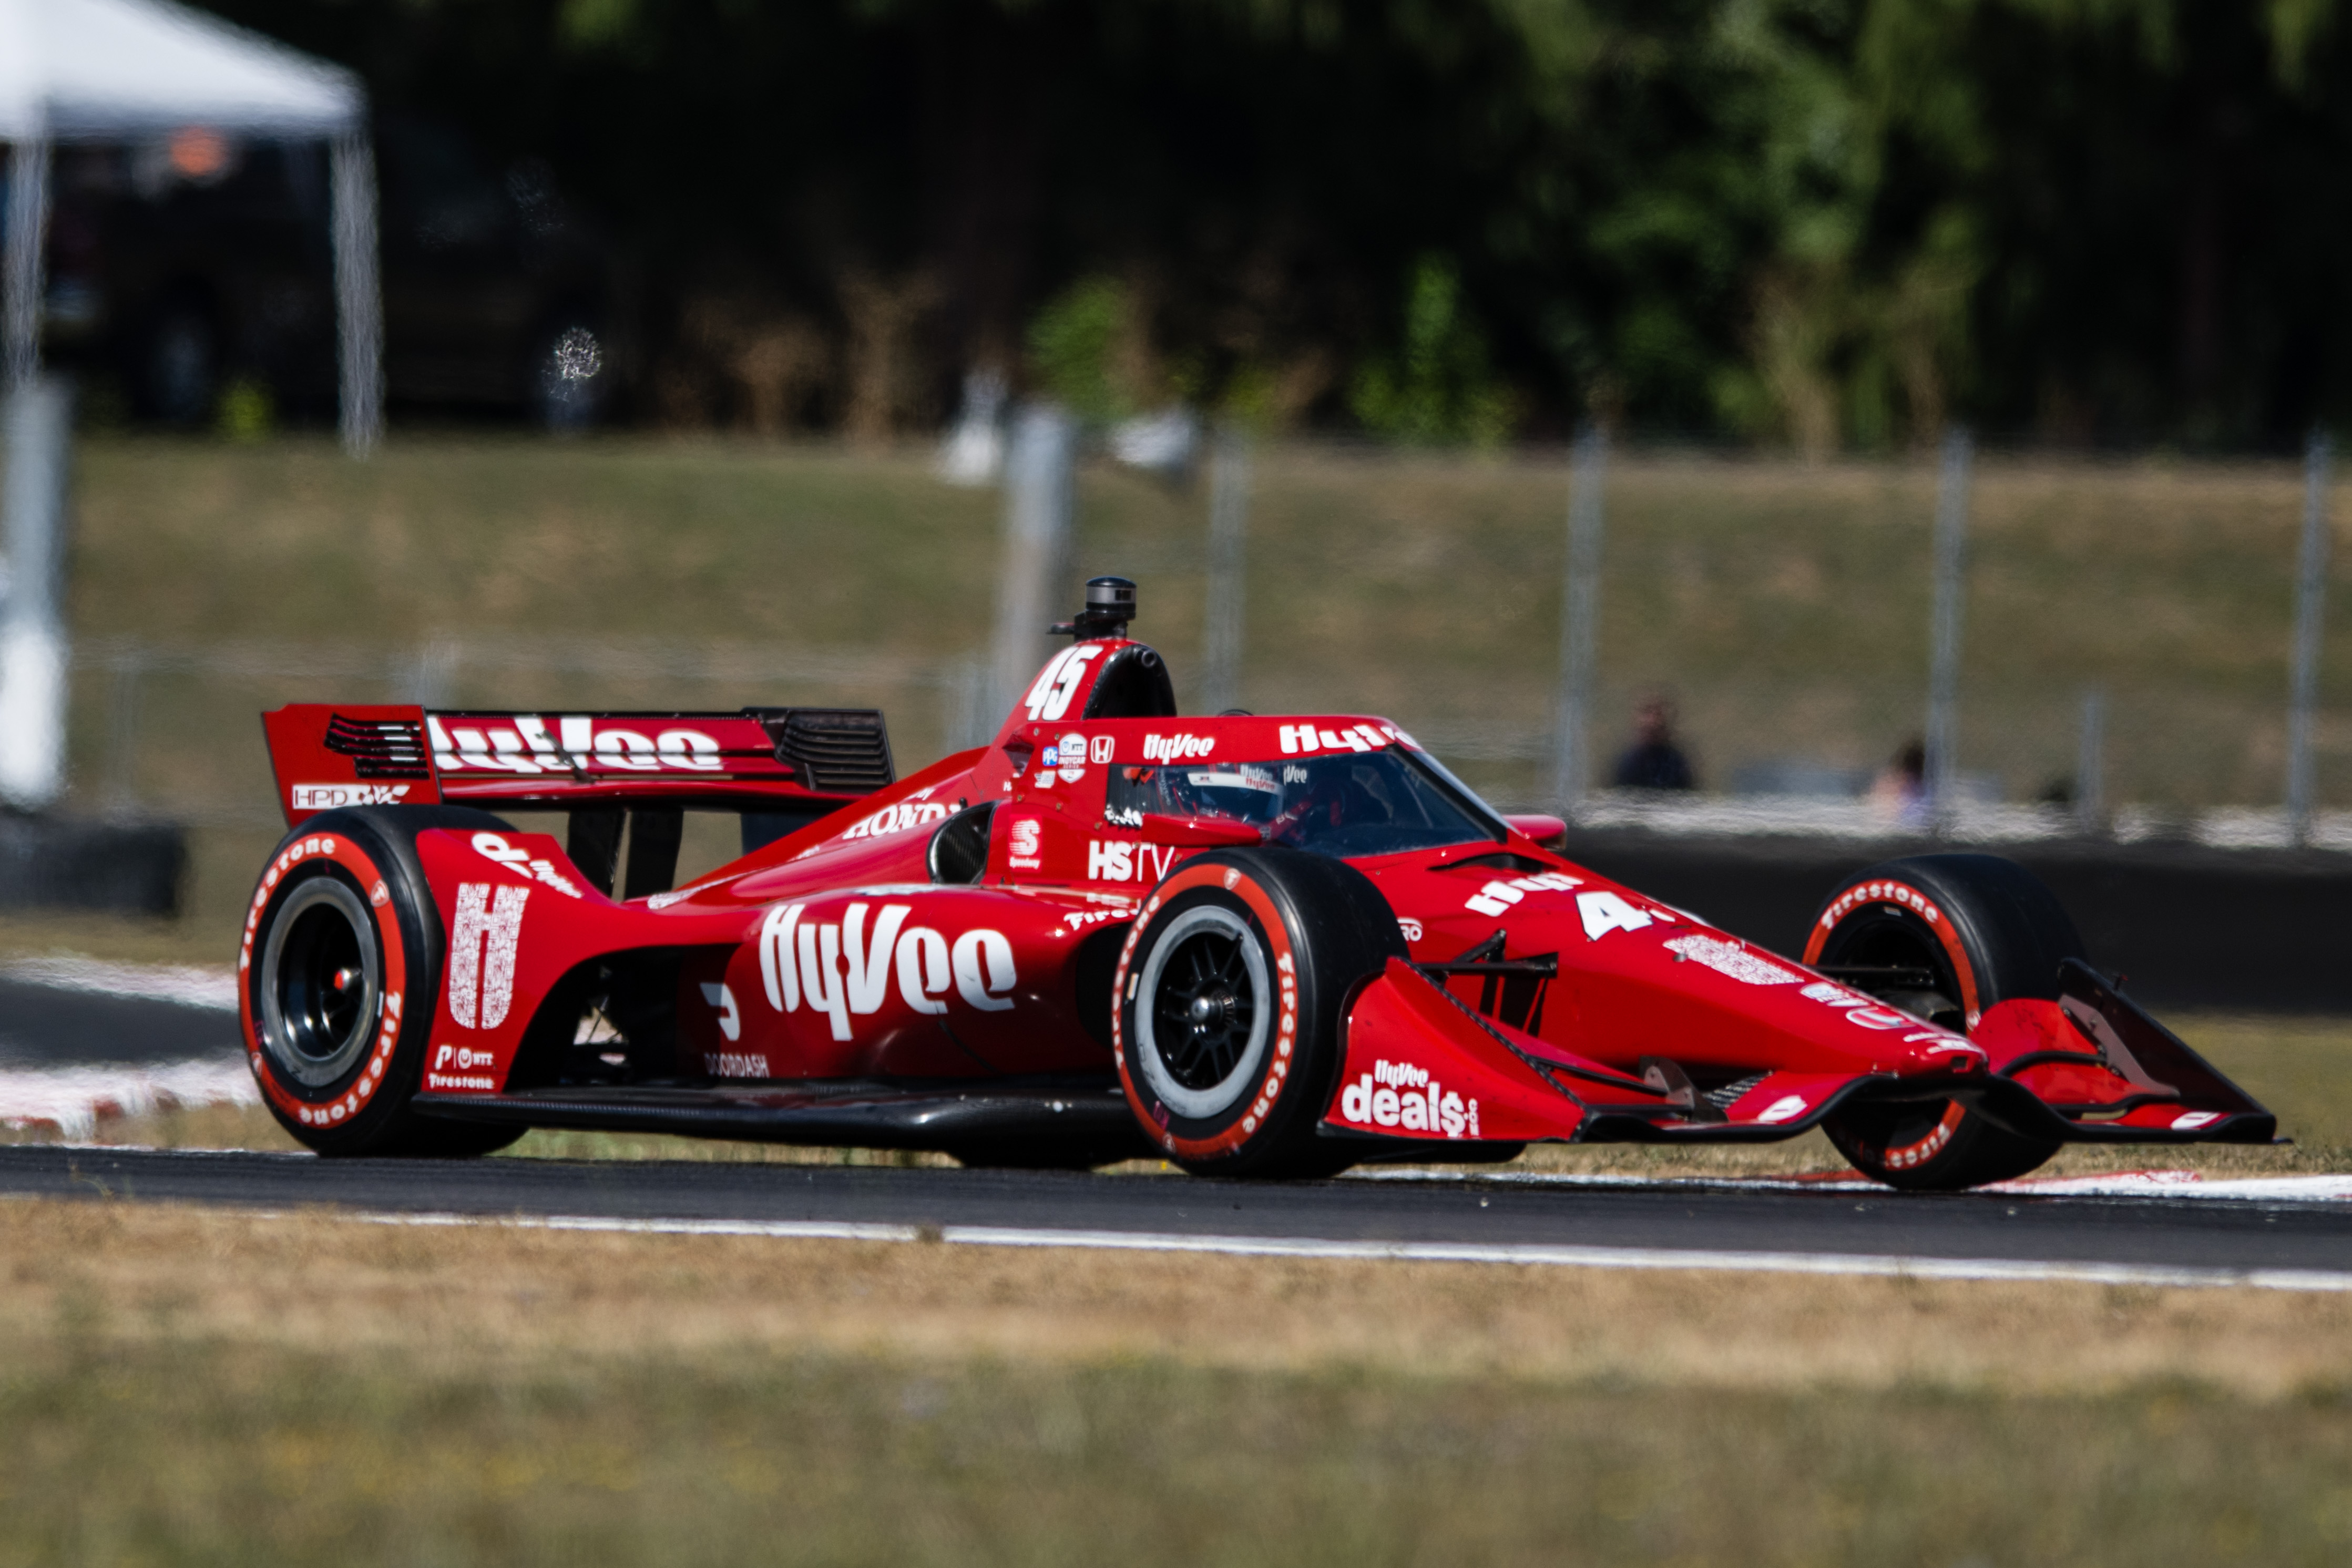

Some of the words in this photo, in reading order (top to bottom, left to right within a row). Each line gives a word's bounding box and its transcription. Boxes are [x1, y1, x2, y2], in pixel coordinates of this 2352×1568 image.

[1025, 645, 1103, 721] 45
[1143, 734, 1215, 765] HyVee
[295, 790, 348, 806] HPD
[842, 803, 963, 839] HOND
[1009, 856, 1040, 870] Speedway
[1088, 840, 1175, 882] HSTV
[240, 838, 335, 972] Firestone
[1576, 891, 1676, 941] 4
[1821, 882, 1938, 929] Firestone
[759, 903, 1017, 1042] HyVee
[1112, 895, 1160, 1069] Firestone
[299, 990, 401, 1125] Firestone
[473, 1052, 493, 1066] NTT
[1245, 952, 1294, 1134] Firestone
[428, 1072, 495, 1090] Firestone
[1374, 1059, 1429, 1090] HyVee
